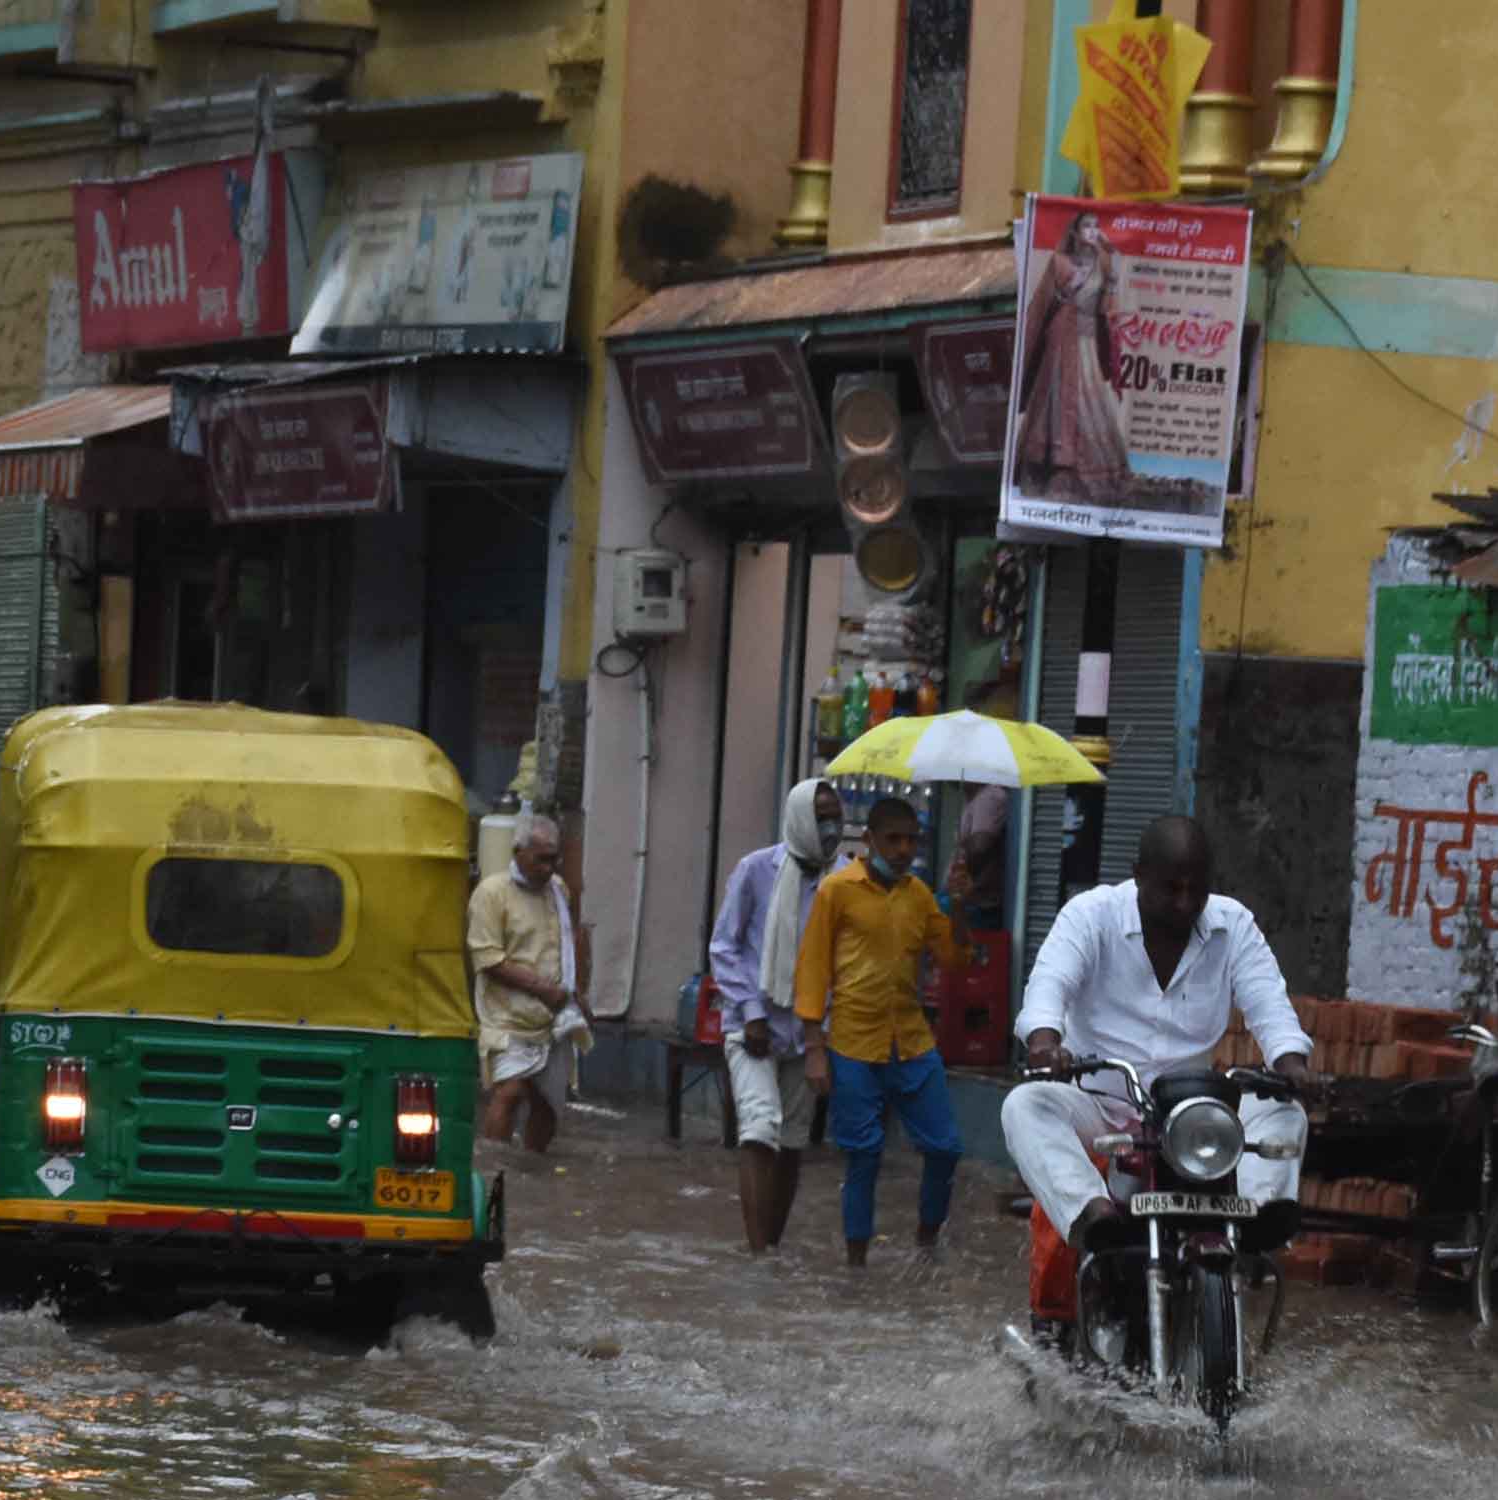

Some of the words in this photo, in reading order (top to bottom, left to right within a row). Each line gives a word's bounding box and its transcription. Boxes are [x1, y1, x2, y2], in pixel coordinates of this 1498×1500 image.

[89, 204, 189, 315] Amul
[1119, 354, 1167, 393] 20%
[1170, 362, 1227, 384] Flat
[1169, 383, 1227, 397] DISCOUNT
[44, 1168, 71, 1181] CNG
[380, 1185, 441, 1202] 6017
